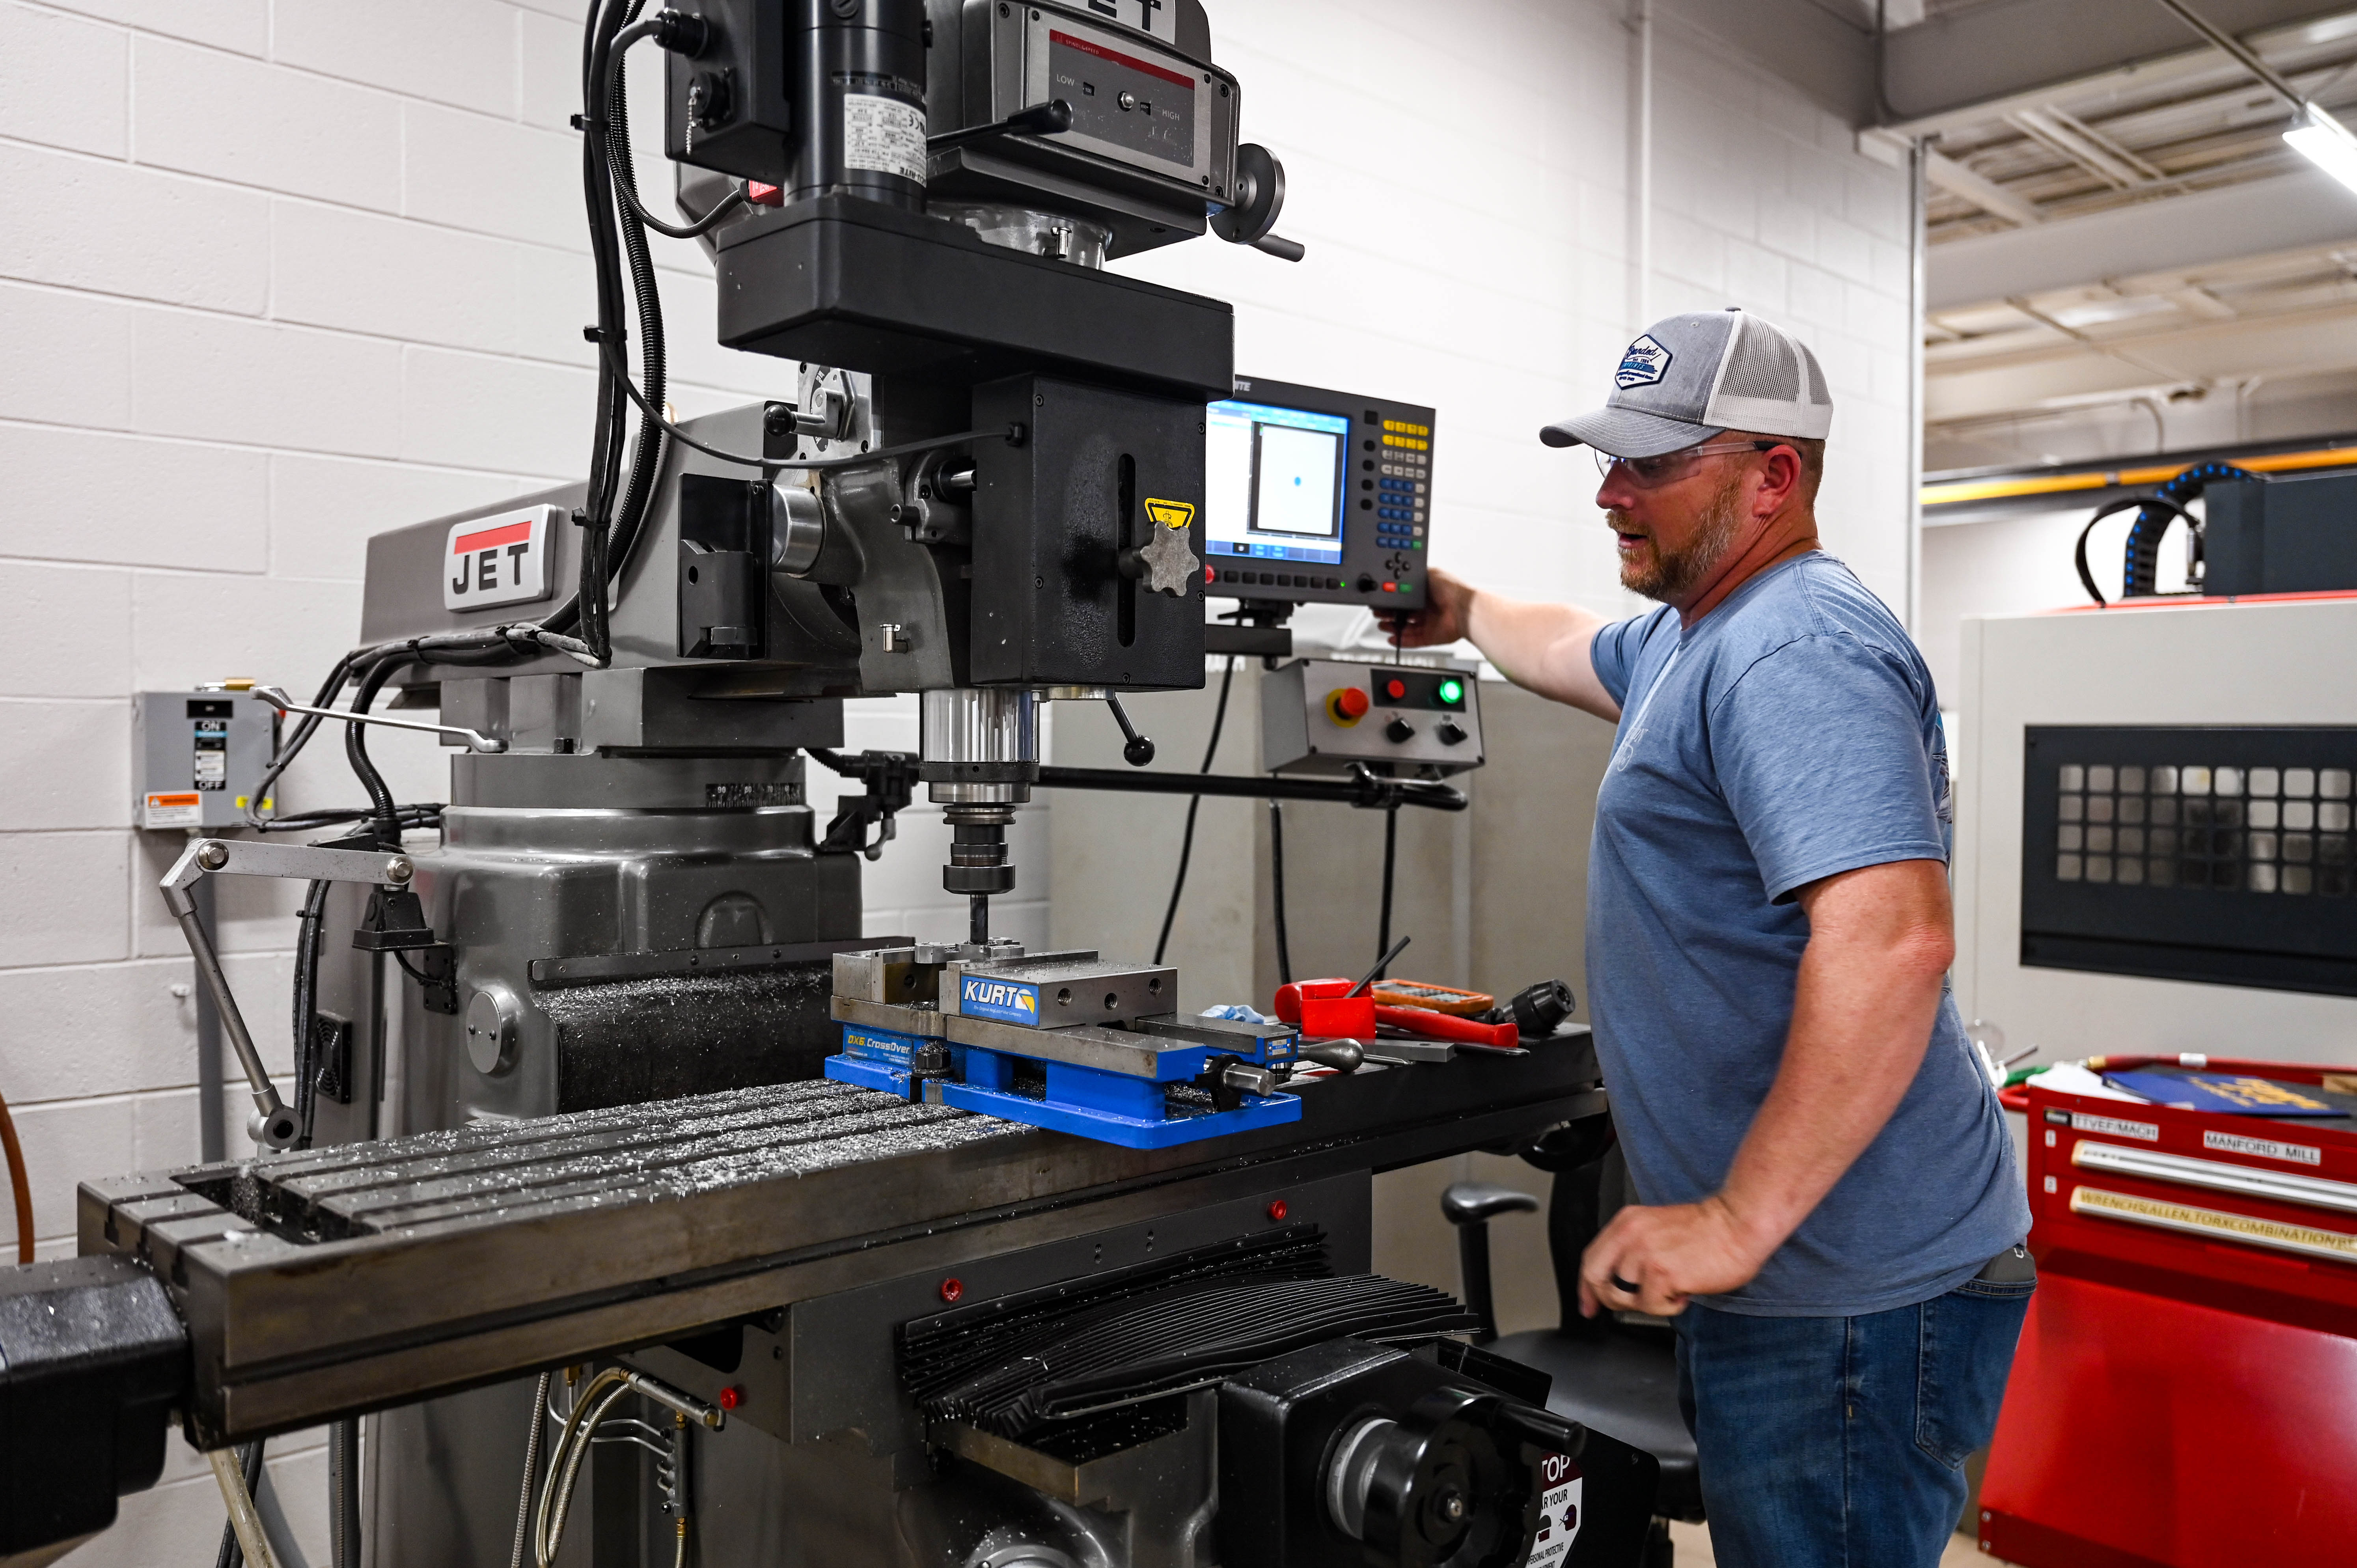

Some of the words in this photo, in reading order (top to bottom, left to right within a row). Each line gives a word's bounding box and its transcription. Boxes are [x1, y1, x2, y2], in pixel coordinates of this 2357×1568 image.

[1088, 0, 1161, 32] ET
[1056, 74, 1075, 86] LOW
[1162, 109, 1180, 121] HIGH
[453, 543, 529, 595] JET
[201, 720, 220, 731] ON
[198, 781, 223, 791] OFF
[964, 980, 1019, 1007] KURT
[867, 1038, 910, 1054] CrossOver
[2206, 1133, 2278, 1155] MANFORD
[2286, 1146, 2319, 1162] MILL
[1549, 1489, 1568, 1507] YOUR
[1545, 1542, 1564, 1559] PROTECTIVE
